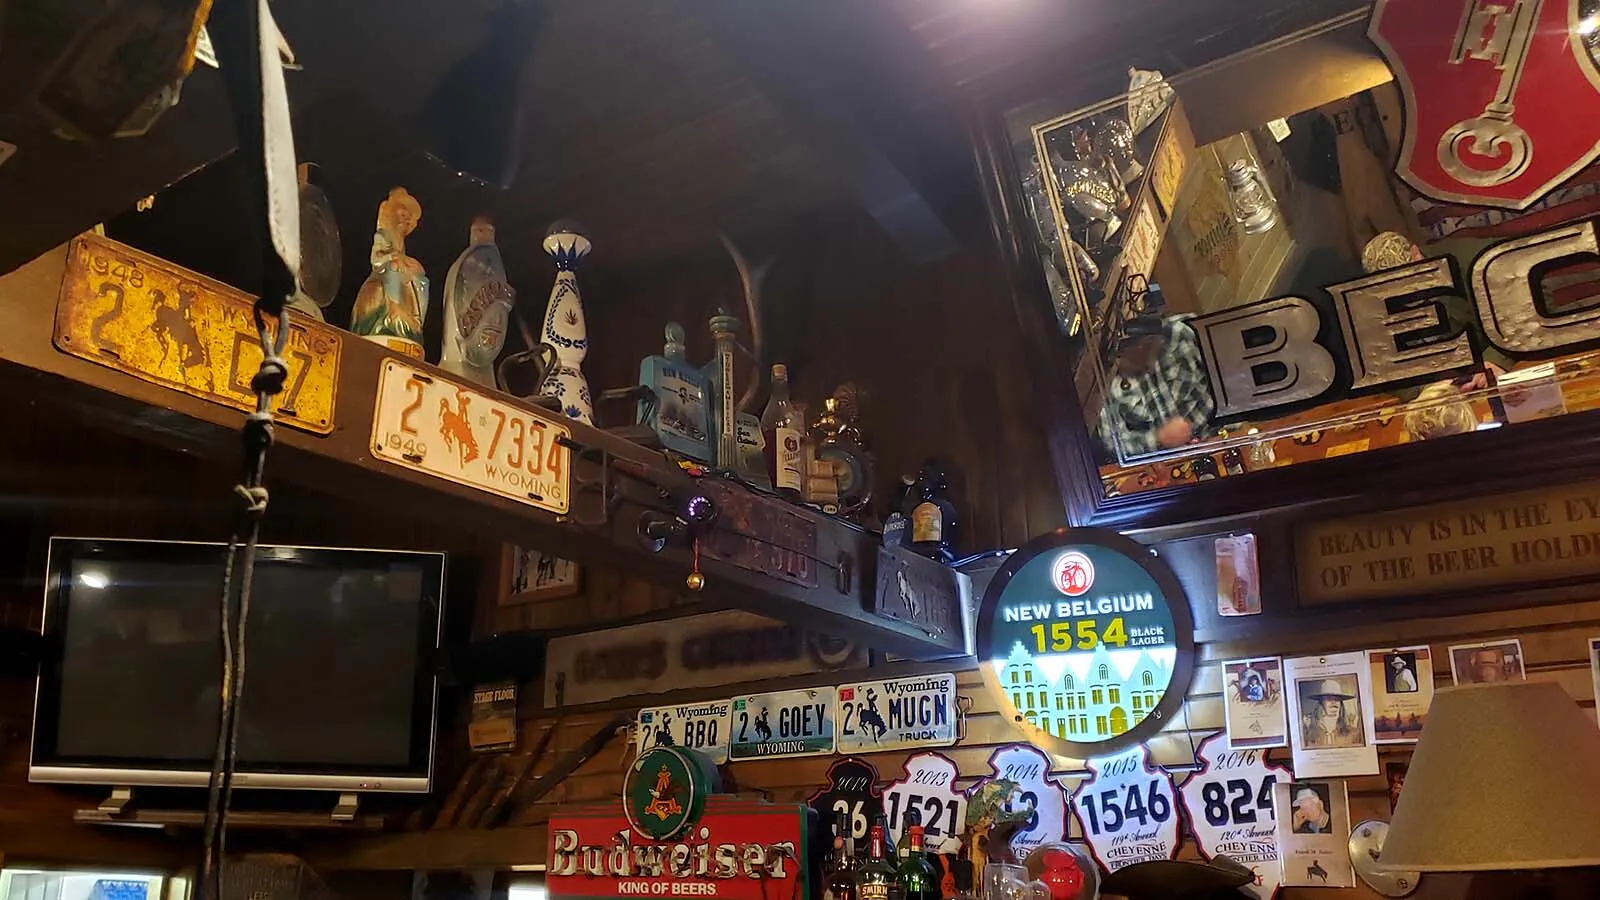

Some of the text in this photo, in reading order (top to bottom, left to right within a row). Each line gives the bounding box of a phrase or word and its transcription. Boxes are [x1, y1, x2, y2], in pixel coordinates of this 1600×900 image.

[91, 282, 125, 348] 2
[220, 303, 329, 355] WYING
[384, 433, 428, 457] 1949
[400, 378, 562, 483] 2 7334
[485, 463, 562, 499] WYOMING
[1319, 525, 1416, 556] BEAUTY
[1428, 517, 1451, 541] IS
[1459, 511, 1488, 536] IN
[1492, 503, 1551, 530] THE
[1320, 566, 1352, 588] OF
[1364, 556, 1416, 583] THE
[1427, 545, 1497, 576] BEER
[1004, 593, 1153, 622] NEW BELGIUM
[1031, 617, 1128, 654] 1554
[1131, 626, 1164, 638] BLACK
[1131, 635, 1165, 646] LAGER
[882, 677, 949, 697] Wyoming
[676, 704, 728, 720] Wyoming
[738, 703, 826, 742] 2 GOEY
[842, 693, 947, 735] 2 MUGN
[684, 719, 718, 748] BBQ
[756, 741, 805, 755] WYOMING
[899, 729, 937, 742] TRUCK
[1003, 762, 1040, 780] 2014
[1102, 754, 1138, 779] 2015
[1214, 750, 1257, 771] 2016
[912, 769, 949, 787] 2013
[888, 791, 959, 839] 1521
[1081, 779, 1171, 836] 1546
[1202, 774, 1276, 827] 824
[551, 827, 796, 880] Budweiser
[1106, 841, 1167, 859] CHEYENNE
[1215, 841, 1277, 853] CHEYENN
[618, 882, 649, 894] KING
[651, 883, 669, 894] OF
